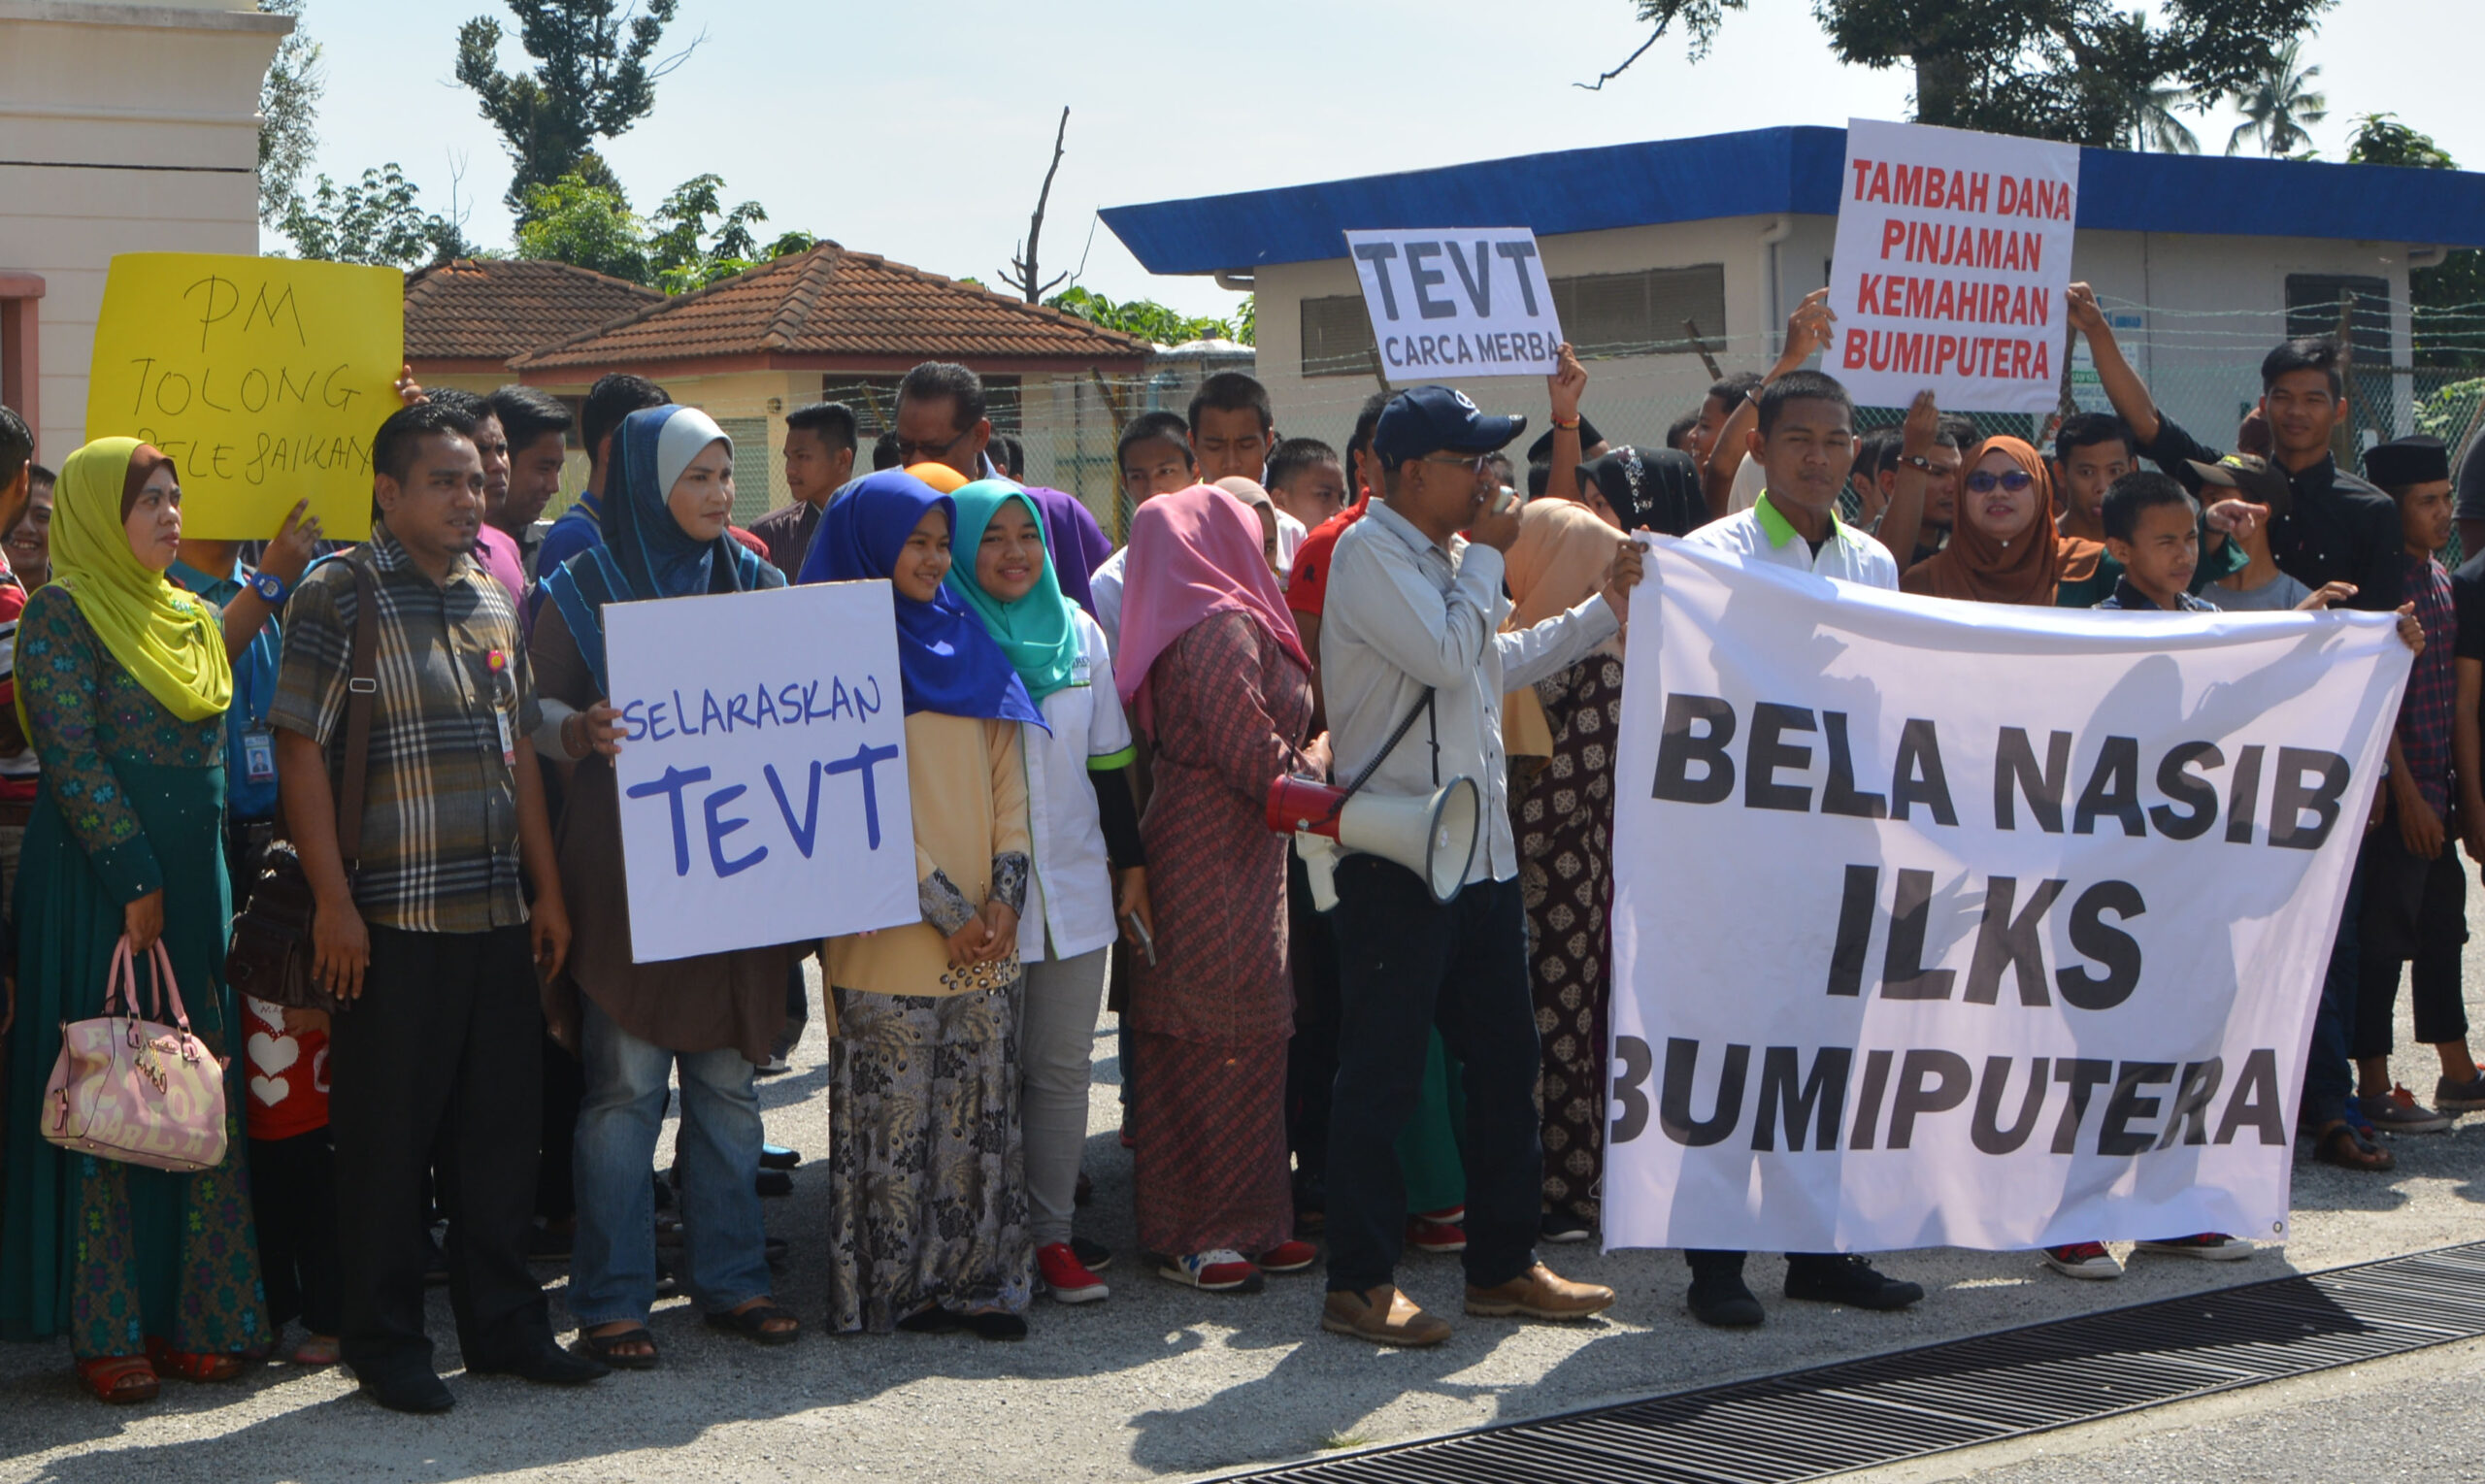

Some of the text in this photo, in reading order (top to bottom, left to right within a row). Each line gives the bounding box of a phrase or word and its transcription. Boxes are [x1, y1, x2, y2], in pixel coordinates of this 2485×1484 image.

[1853, 158, 2071, 221] TAMBAH DANA
[1880, 218, 2042, 273] PINJAMAN
[183, 274, 306, 353] PM
[1353, 240, 1540, 321] TEVT
[1857, 273, 2049, 326] KEMAHIRAN
[1384, 333, 1478, 368] CARCA
[1842, 328, 2049, 380] BUMIPUTERA
[131, 357, 362, 416] TOLONG
[621, 675, 881, 742] SELARASKAN
[1650, 692, 2351, 851] BELA NASIB
[626, 742, 899, 878] TEVT
[1826, 863, 2147, 1011] ILKS
[1609, 1035, 2287, 1157] BUMIPUTERA
